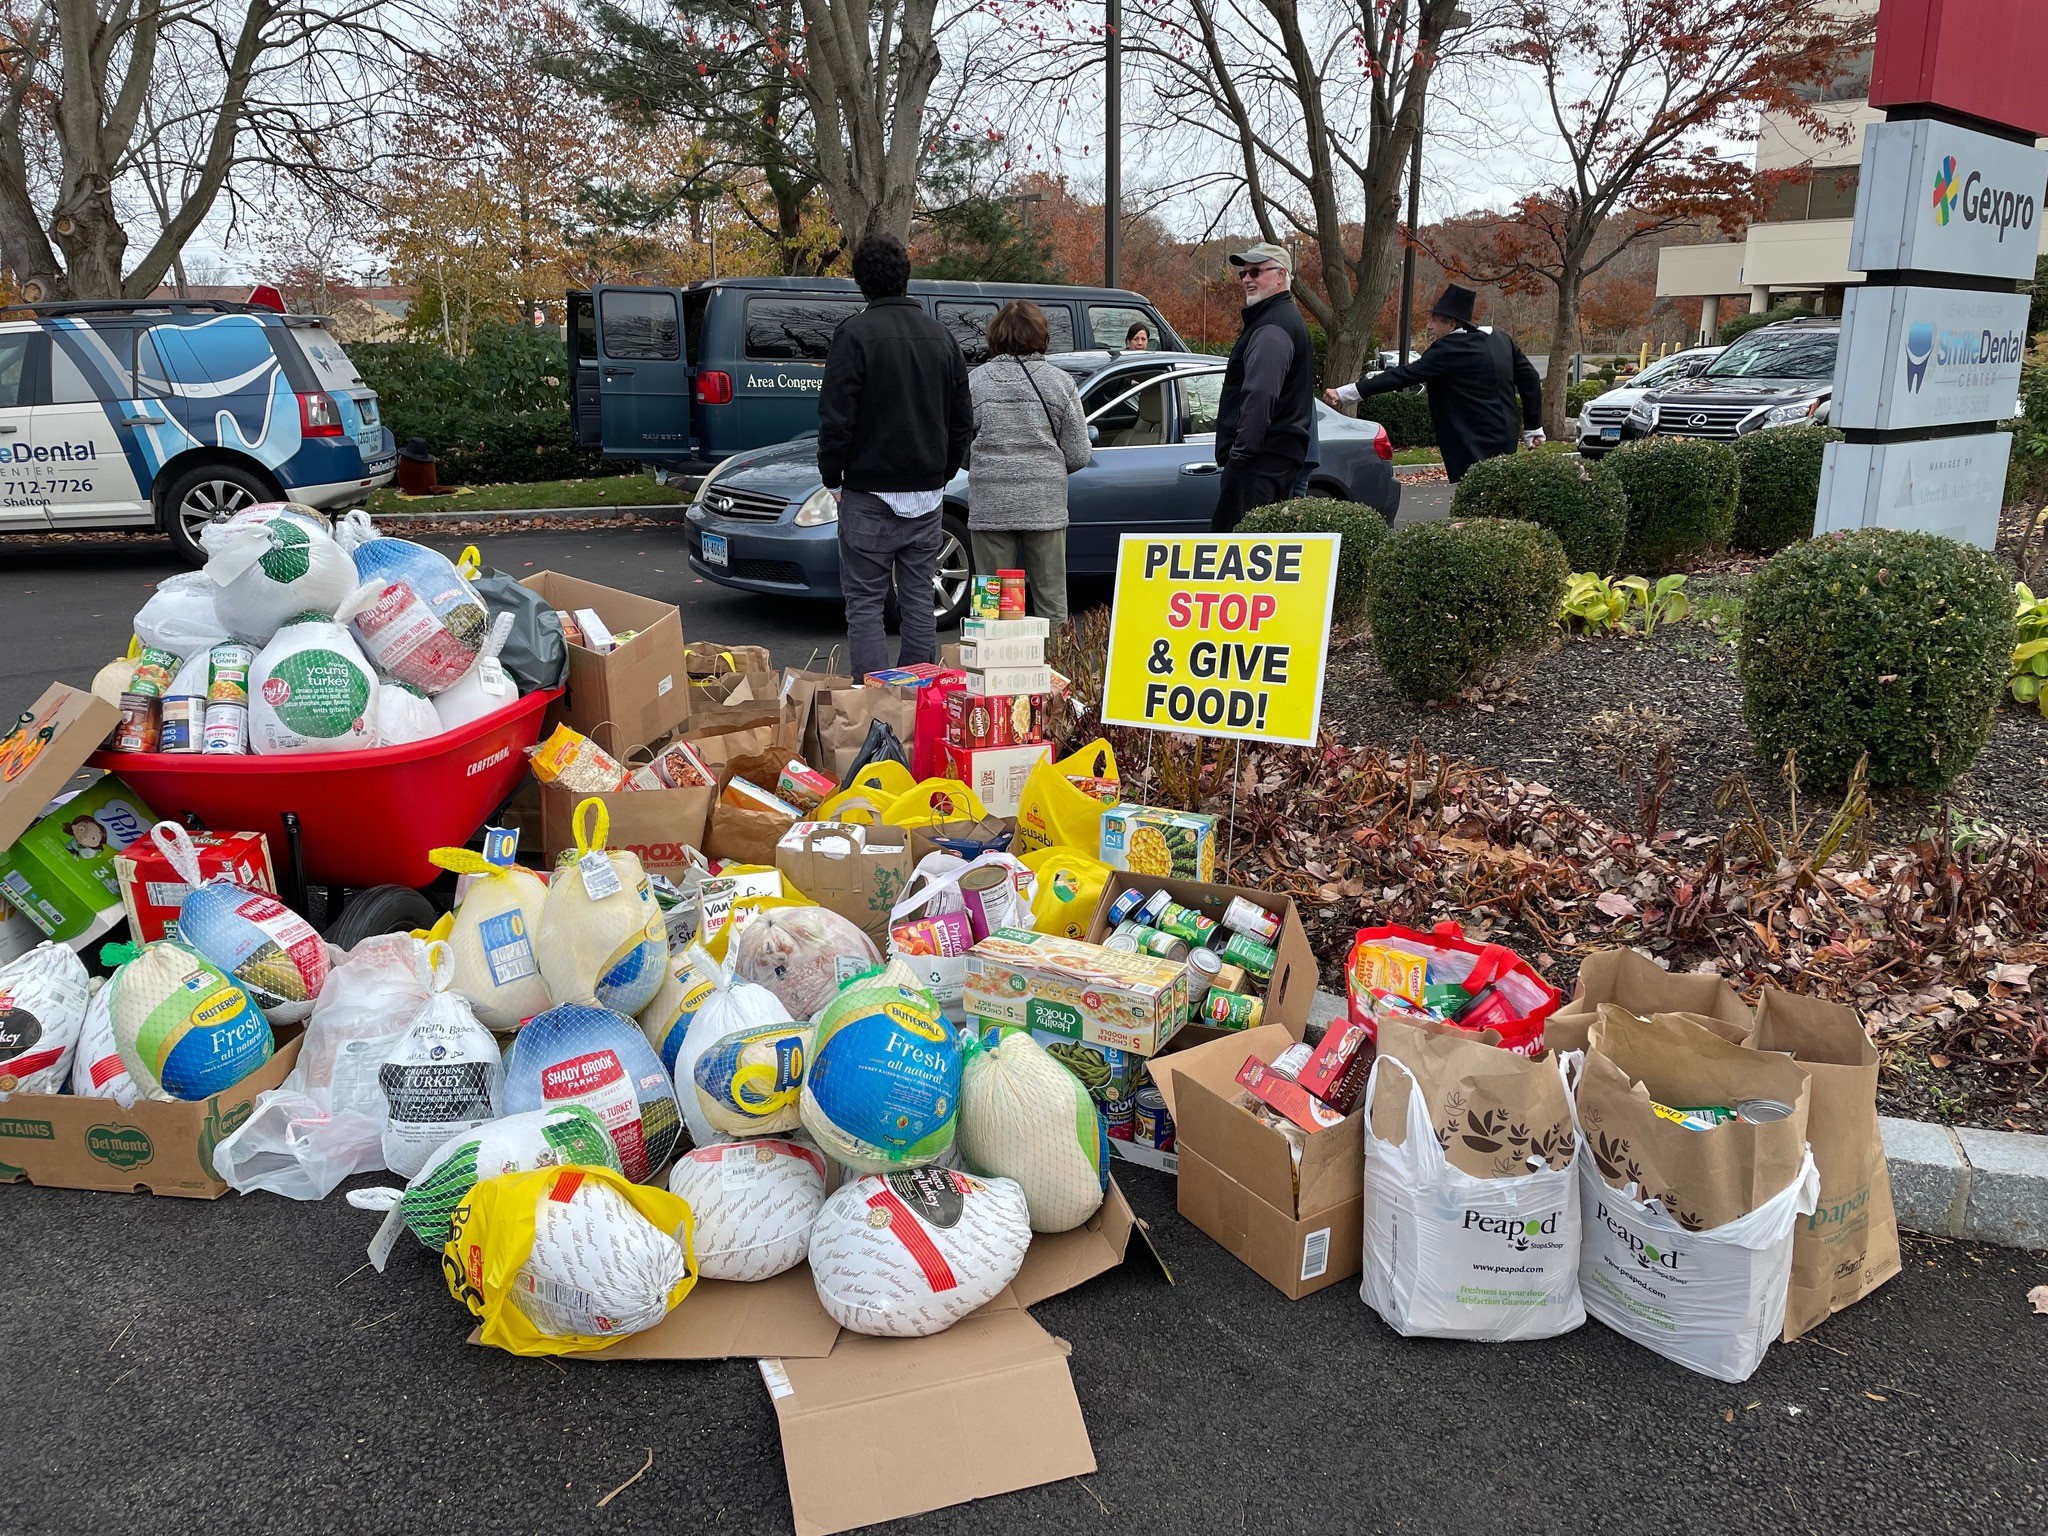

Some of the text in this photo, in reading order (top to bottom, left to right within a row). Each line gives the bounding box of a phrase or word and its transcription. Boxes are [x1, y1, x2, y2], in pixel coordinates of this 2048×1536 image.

[1962, 170, 2034, 243] Gexpro
[1936, 329, 2024, 366] SmileDental
[747, 374, 823, 392] Area Congreg
[1958, 372, 1997, 387] CENTER
[1929, 458, 1973, 470] MANAGED BY
[4, 479, 93, 495] 712-7726
[3, 498, 51, 507] Shelton
[1144, 543, 1304, 582] PLEASE
[377, 586, 406, 611] BROOK
[1168, 592, 1277, 632] STOP
[1147, 639, 1291, 684] & GIVE
[306, 667, 349, 677] young
[307, 676, 350, 687] turkey
[864, 676, 882, 688] Colgate
[1144, 683, 1269, 729] FOOD!
[466, 746, 510, 777] CRAFTSMAN
[564, 748, 578, 765] Rolls
[1020, 827, 1053, 847] eusabl
[1106, 834, 1115, 846] 12
[643, 861, 687, 870] tjmaxx.com
[674, 921, 688, 933] my
[707, 915, 745, 928] EVERAY
[937, 924, 948, 943] Sweet
[1362, 960, 1375, 988] Gold
[1412, 963, 1421, 999] Velveeta
[197, 991, 244, 1022] BUTTERBALL
[974, 1004, 1014, 1017] 5 CHICKEN
[1035, 1006, 1076, 1025] Choice
[892, 1006, 940, 1036] BUTTERBALL
[1036, 1018, 1071, 1034] Healthy
[210, 1009, 260, 1054] Fresh
[1100, 1028, 1128, 1040] NOODLE
[221, 1047, 235, 1061] all
[236, 1029, 262, 1054] natural
[1097, 1034, 1140, 1049] 5 CHICKEN
[884, 1031, 948, 1073] Fresh
[1109, 1047, 1117, 1058] 8
[433, 1066, 465, 1075] YOUNG
[547, 1055, 615, 1086] SHADY BROOK
[782, 1048, 790, 1084] Premium
[887, 1059, 944, 1085] all natural
[404, 1075, 462, 1088] TURKEY
[568, 1075, 600, 1090] FARMS
[1335, 1053, 1363, 1100] TURKEY
[1341, 1055, 1375, 1110] STUFFING
[607, 1099, 633, 1117] TURKEY
[222, 1118, 233, 1129] Del
[91, 1137, 149, 1152] Del Monte
[109, 1151, 135, 1162] Quality
[918, 1178, 940, 1207] Turkey
[1462, 1210, 1558, 1242] Peapod
[1597, 1200, 1678, 1270] Peapod
[859, 1230, 890, 1246] Natural
[1530, 1242, 1563, 1250] Stop&Shop
[872, 1249, 902, 1270] Natural
[1473, 1263, 1544, 1274] www.peapod.com
[1604, 1255, 1666, 1299] www.peapod.com
[1460, 1286, 1498, 1295] Freshness
[1507, 1289, 1526, 1297] your
[1456, 1296, 1548, 1307] Satisfaction Guaranteed.
[1627, 1302, 1677, 1332] Guaranteed.
